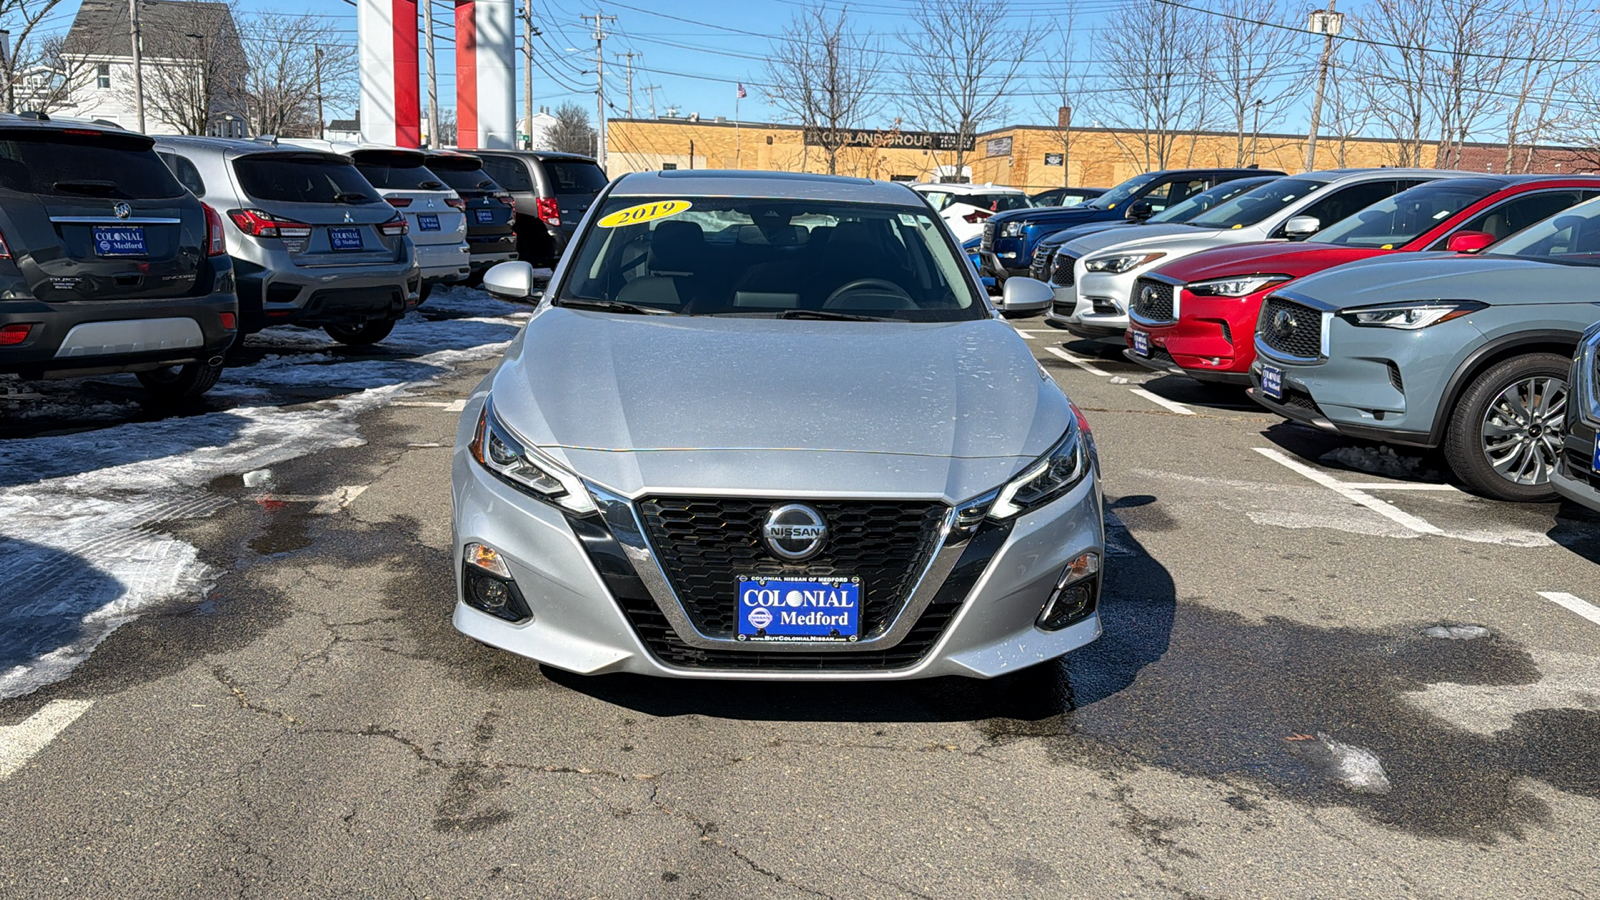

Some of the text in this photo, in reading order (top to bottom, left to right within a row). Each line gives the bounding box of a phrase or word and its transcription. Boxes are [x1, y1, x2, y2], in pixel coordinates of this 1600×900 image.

[886, 133, 932, 148] GROUP
[617, 202, 675, 223] 2019
[95, 232, 143, 241] COLONIAL
[770, 527, 820, 536] NISSAN
[743, 589, 854, 607] COLONIAL
[780, 611, 848, 625] Medford
